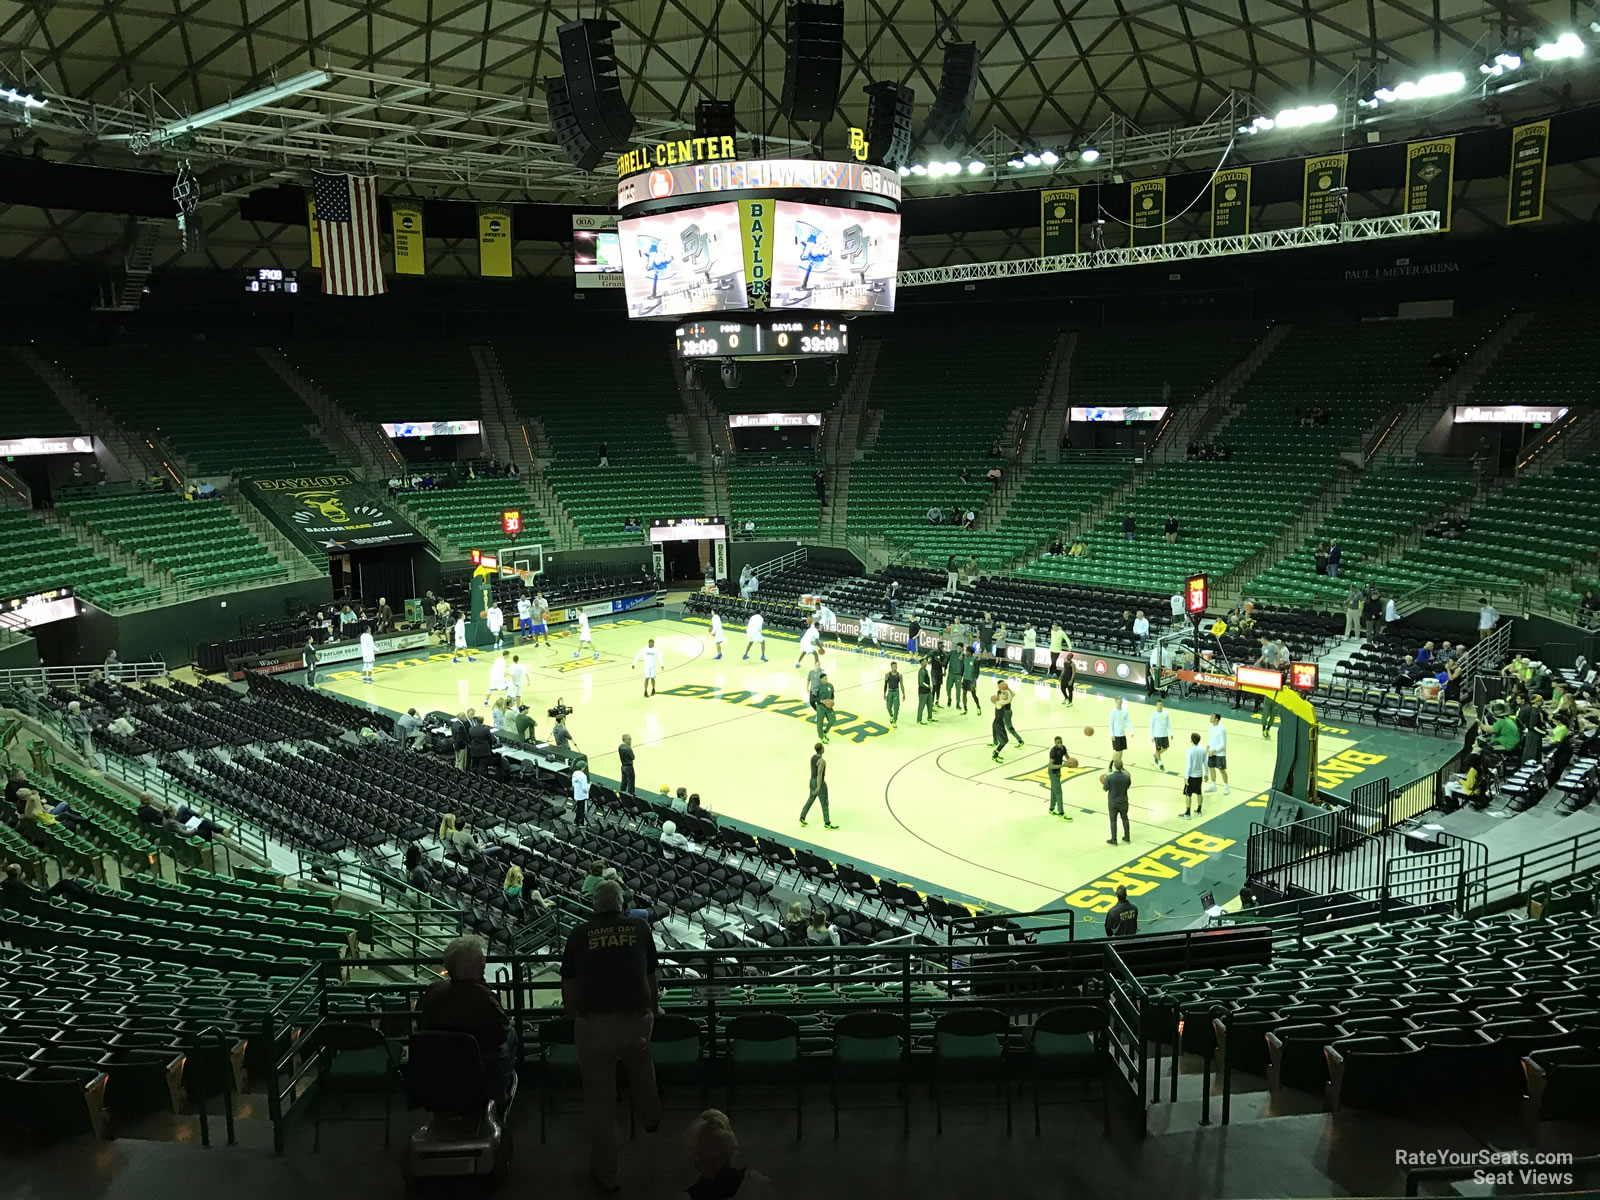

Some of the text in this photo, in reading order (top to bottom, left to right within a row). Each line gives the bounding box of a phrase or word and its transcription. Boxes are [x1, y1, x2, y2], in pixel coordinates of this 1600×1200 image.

[656, 135, 736, 167] CENTER
[850, 127, 869, 161] BU
[1411, 144, 1451, 159] BAYLOR
[1308, 159, 1344, 174] BAYLOR
[1214, 172, 1248, 185] BAYLOR
[1134, 183, 1163, 195] BAYLOR
[1044, 192, 1076, 203] BAYLOR
[750, 203, 765, 295] BAYLOR
[1344, 270, 1370, 280] PAUL
[1383, 265, 1420, 277] MEYER
[1422, 262, 1460, 274] ARENA
[772, 323, 803, 332] BAYLOR
[728, 334, 739, 348] 0
[777, 333, 788, 347] 0
[255, 475, 352, 491] BAYLOR
[259, 659, 279, 668] Waco
[272, 663, 295, 672] Herald
[655, 684, 891, 744] BAYLOR
[1065, 831, 1237, 913] BEARS
[618, 925, 637, 933] DAY
[588, 934, 637, 950] STAFF
